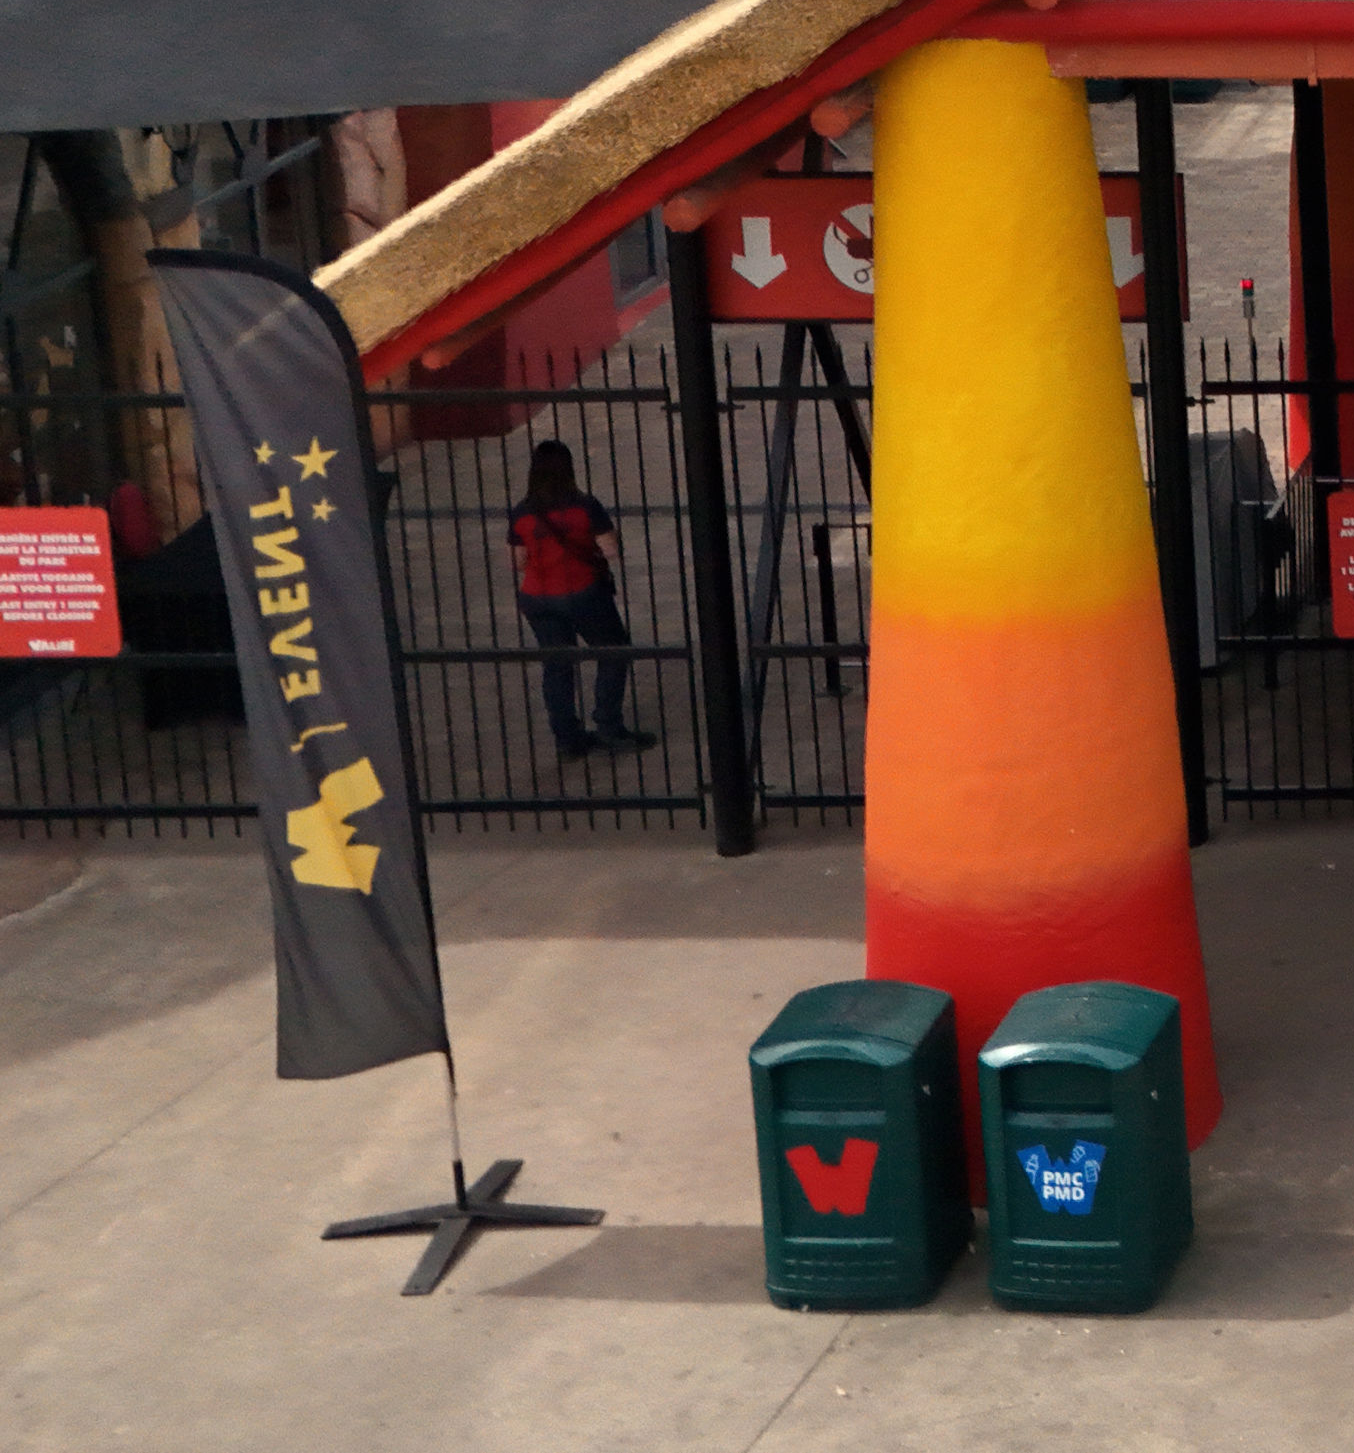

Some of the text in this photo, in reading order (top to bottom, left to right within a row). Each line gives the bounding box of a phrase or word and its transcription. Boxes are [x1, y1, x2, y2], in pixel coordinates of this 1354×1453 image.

[21, 546, 36, 554] LA
[3, 612, 43, 621] BEFORE
[1042, 1170, 1083, 1187] PMC
[1042, 1185, 1085, 1202] PMD
